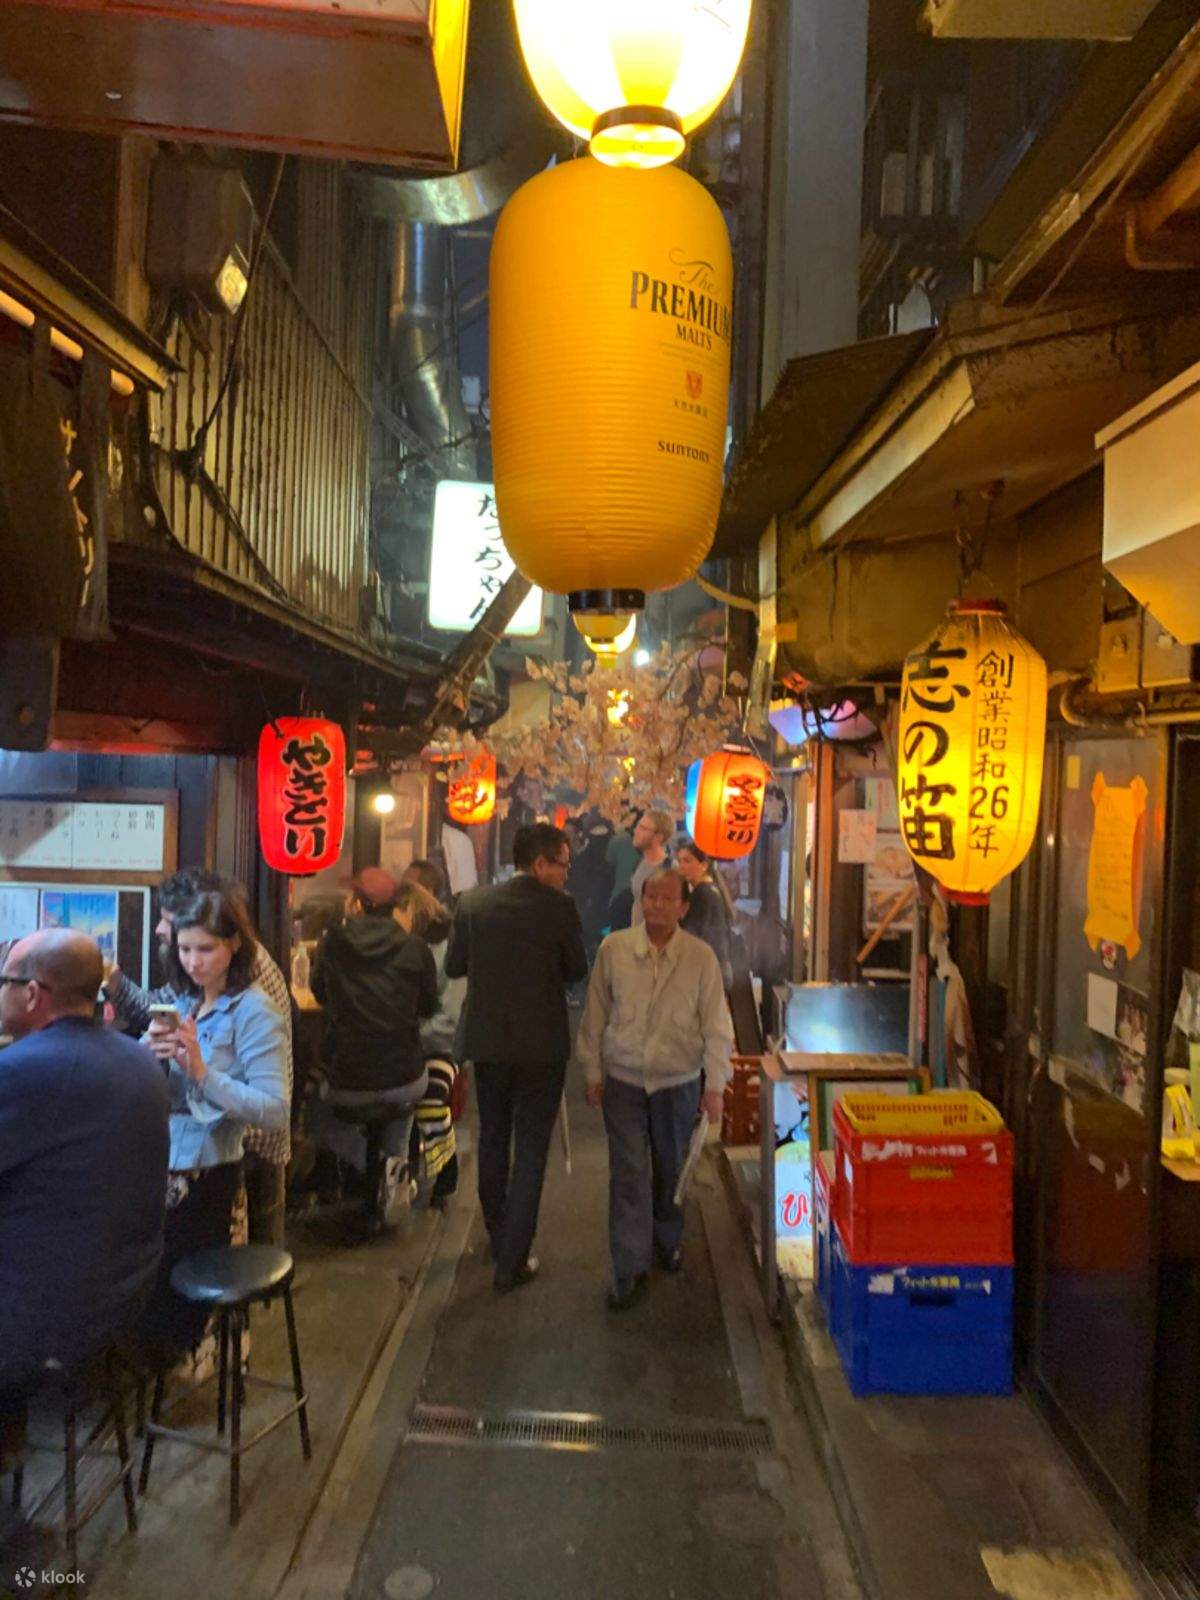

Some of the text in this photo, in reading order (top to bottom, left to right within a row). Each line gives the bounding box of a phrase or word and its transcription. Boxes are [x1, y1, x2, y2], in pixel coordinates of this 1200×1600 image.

[668, 248, 716, 293] The
[675, 323, 712, 351] MALTS
[657, 440, 709, 464] SUNTORY
[469, 494, 504, 619] たっちゃ
[282, 733, 332, 858] やきとり
[969, 649, 1014, 858] 創業昭和26年
